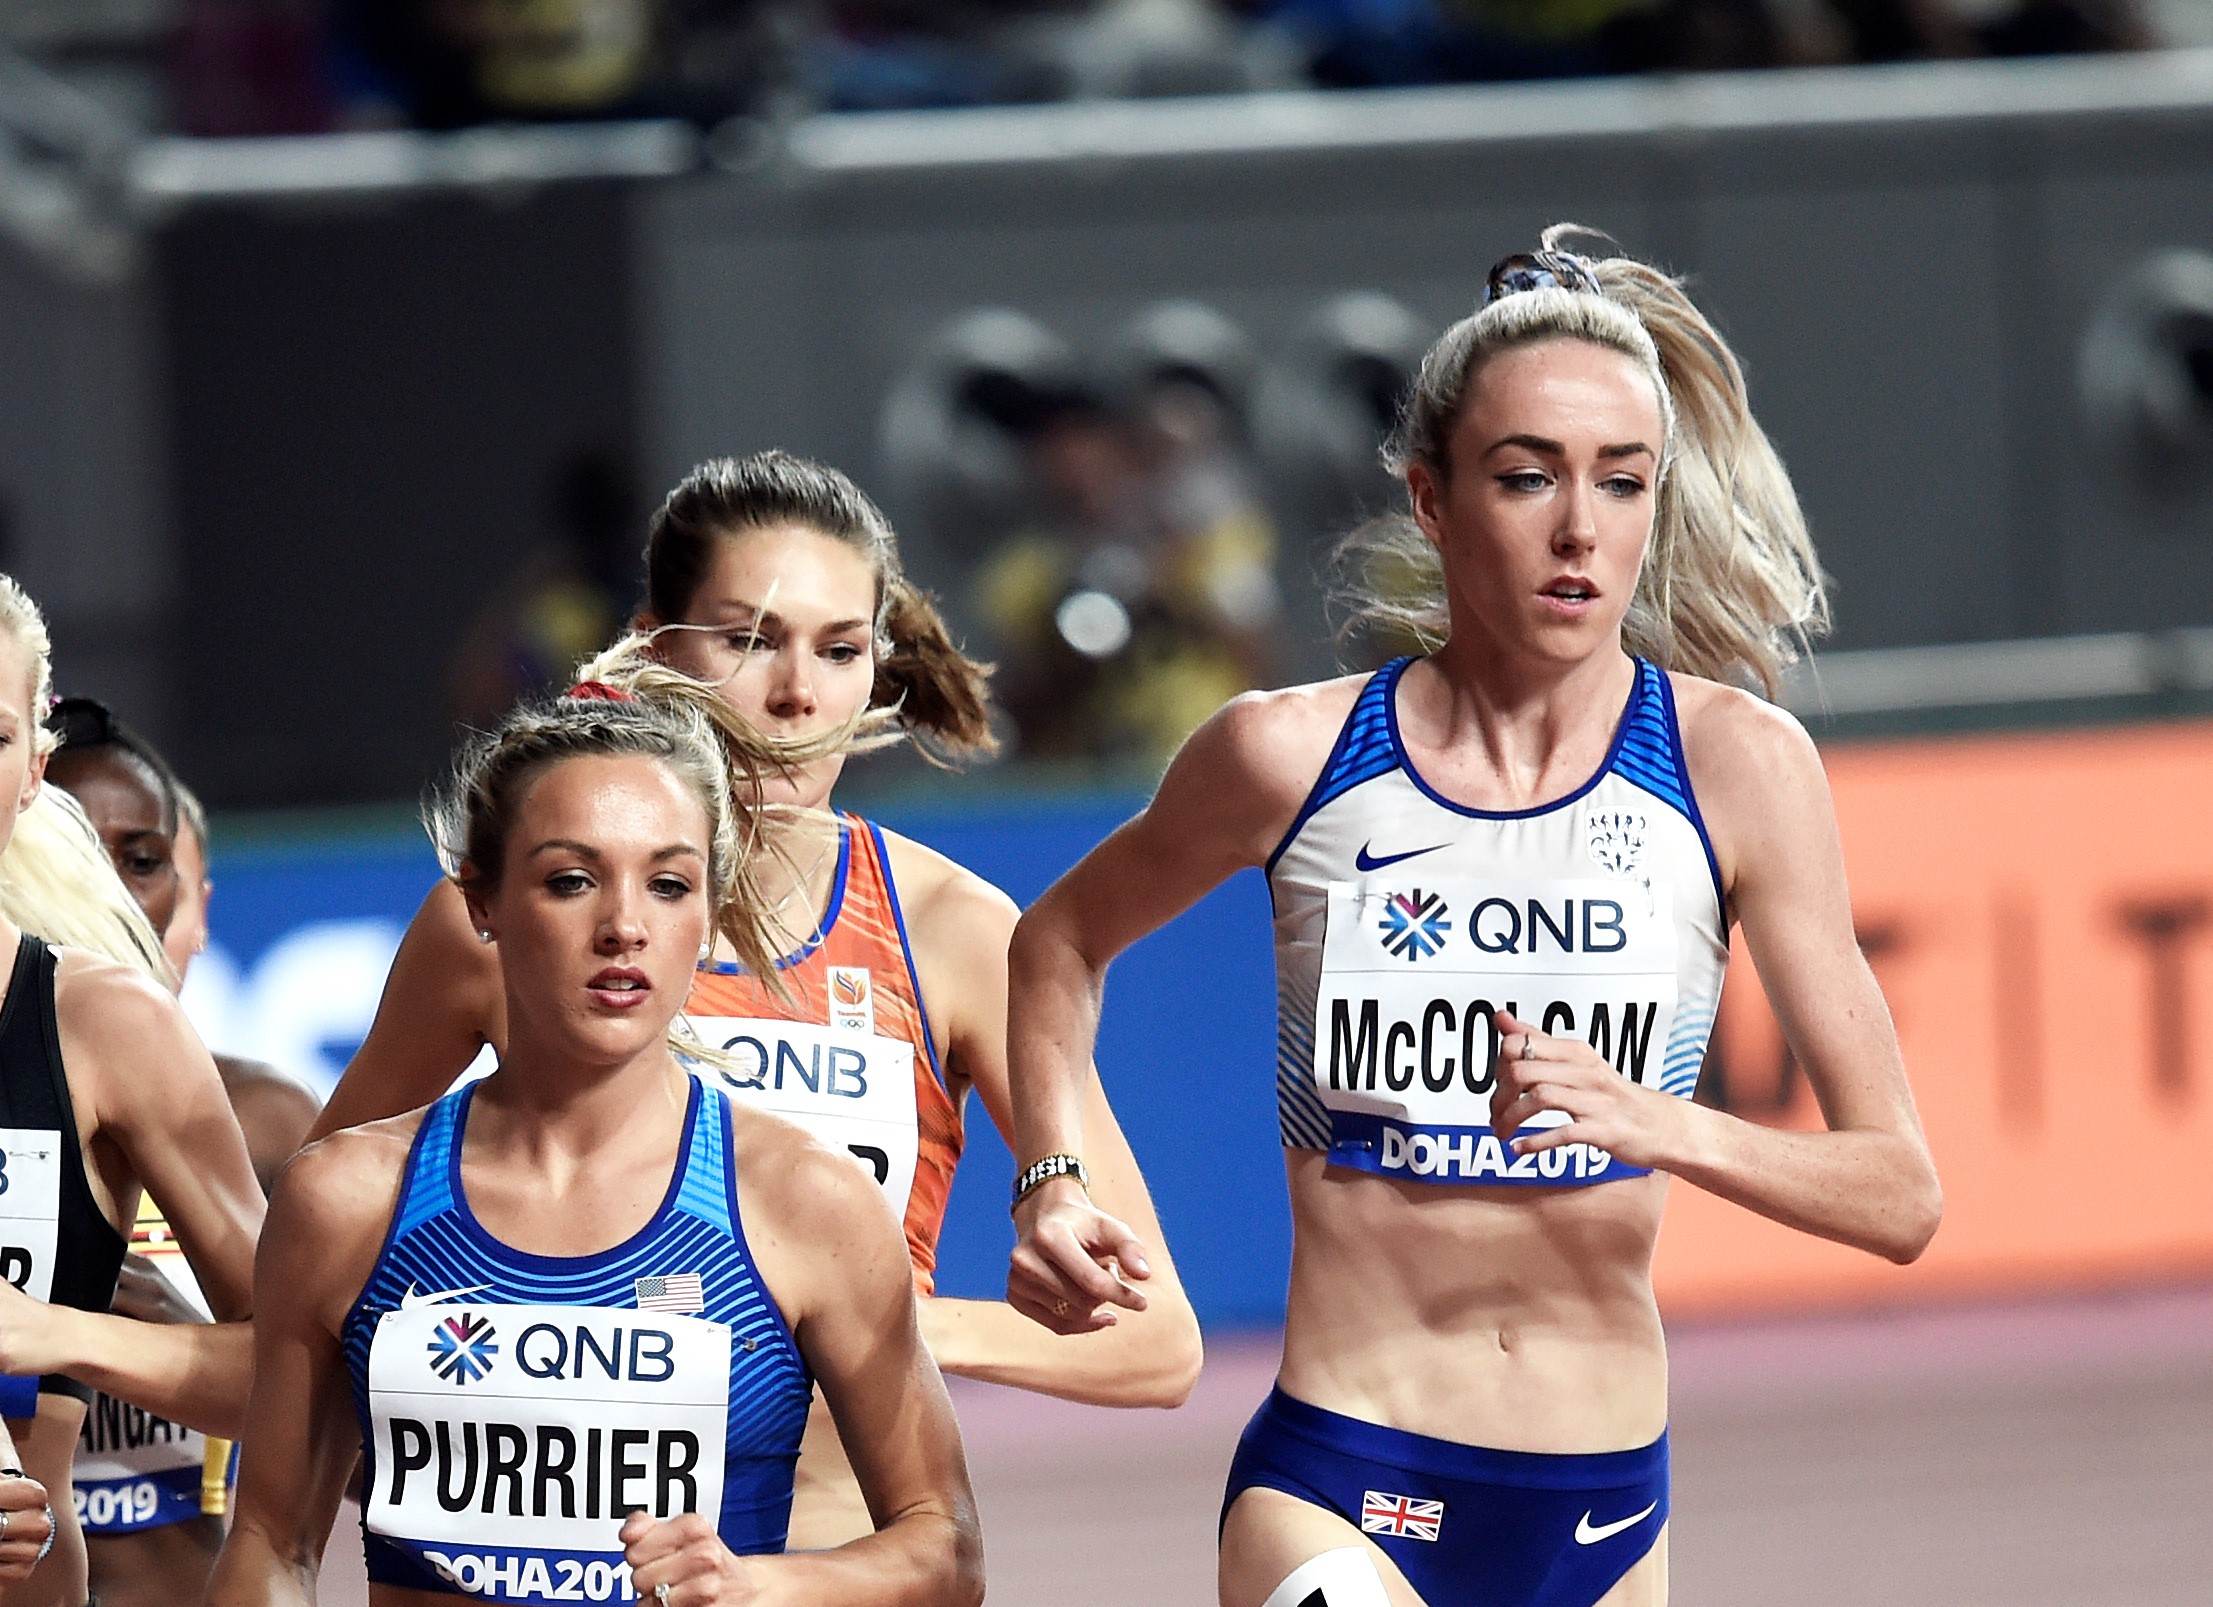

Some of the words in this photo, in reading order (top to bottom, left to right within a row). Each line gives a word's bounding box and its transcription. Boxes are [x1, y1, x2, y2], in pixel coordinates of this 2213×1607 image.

[1468, 897, 1628, 956] QNB
[719, 1035, 868, 1099] QNB
[1329, 997, 1658, 1095] McCOAN
[515, 1323, 675, 1382] QNB
[388, 1417, 700, 1519] PURRIER
